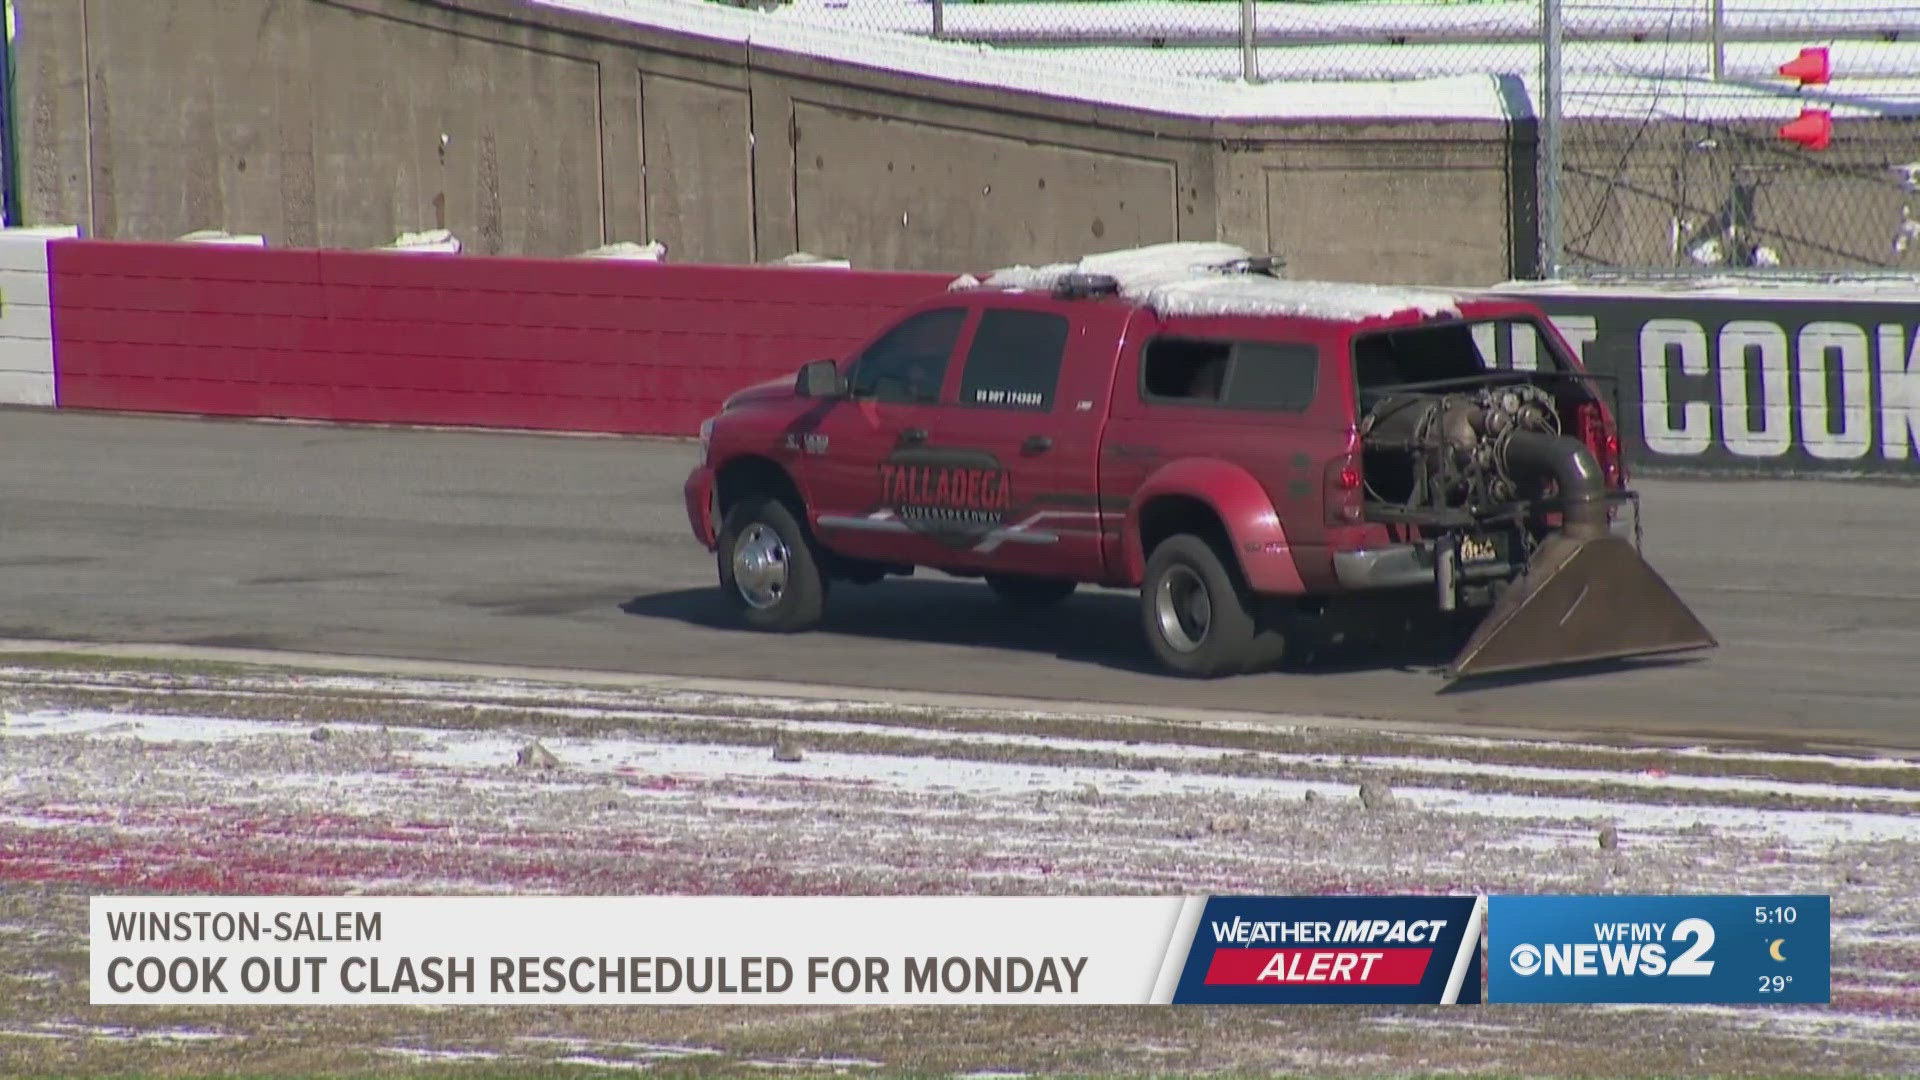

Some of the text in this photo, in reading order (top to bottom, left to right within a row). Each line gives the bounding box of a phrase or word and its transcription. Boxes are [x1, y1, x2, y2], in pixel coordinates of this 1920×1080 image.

[1640, 318, 1920, 461] COOK
[878, 463, 1012, 511] TALLADEGA
[901, 505, 1003, 525] SUPERSPEEDWAY
